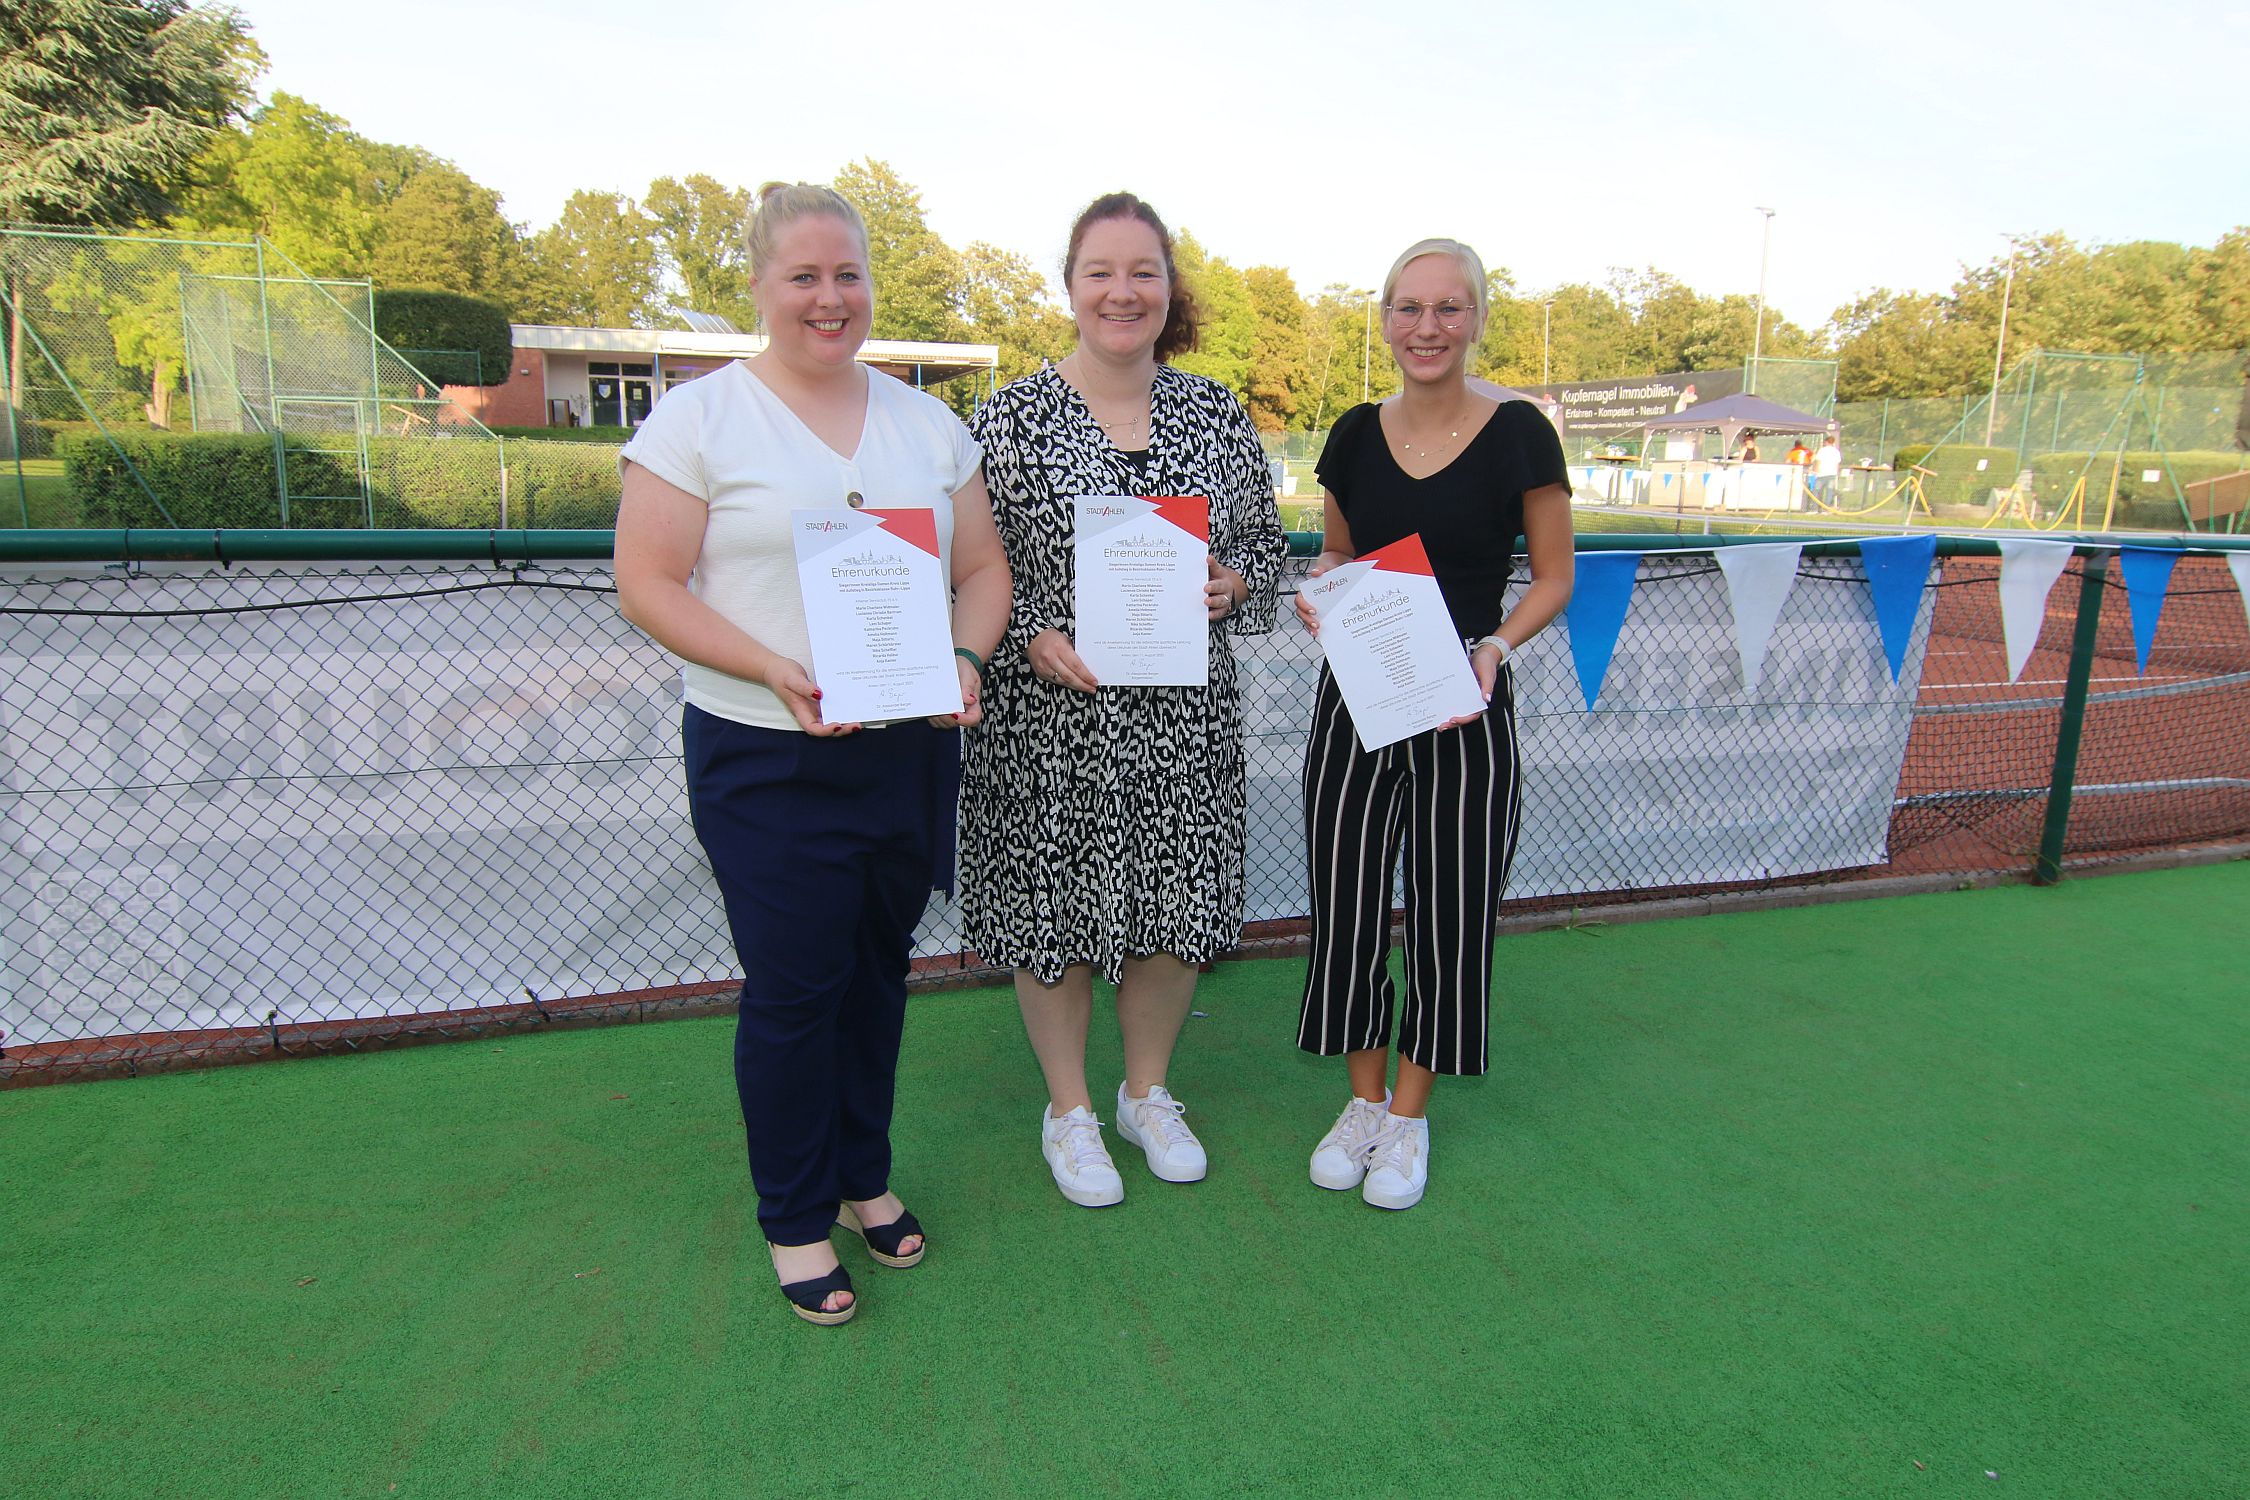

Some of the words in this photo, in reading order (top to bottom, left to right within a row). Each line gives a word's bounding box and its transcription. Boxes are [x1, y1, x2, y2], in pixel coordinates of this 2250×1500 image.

[1619, 383, 1674, 400] Immobilien
[1565, 408, 1593, 419] Erfahren
[1598, 406, 1635, 419] Kompetent
[1640, 404, 1667, 416] Neutral
[1104, 548, 1178, 558] Ehrenurkunde
[831, 565, 910, 578] Ehrenurkunde
[1341, 595, 1411, 629] Ehrenurkunde
